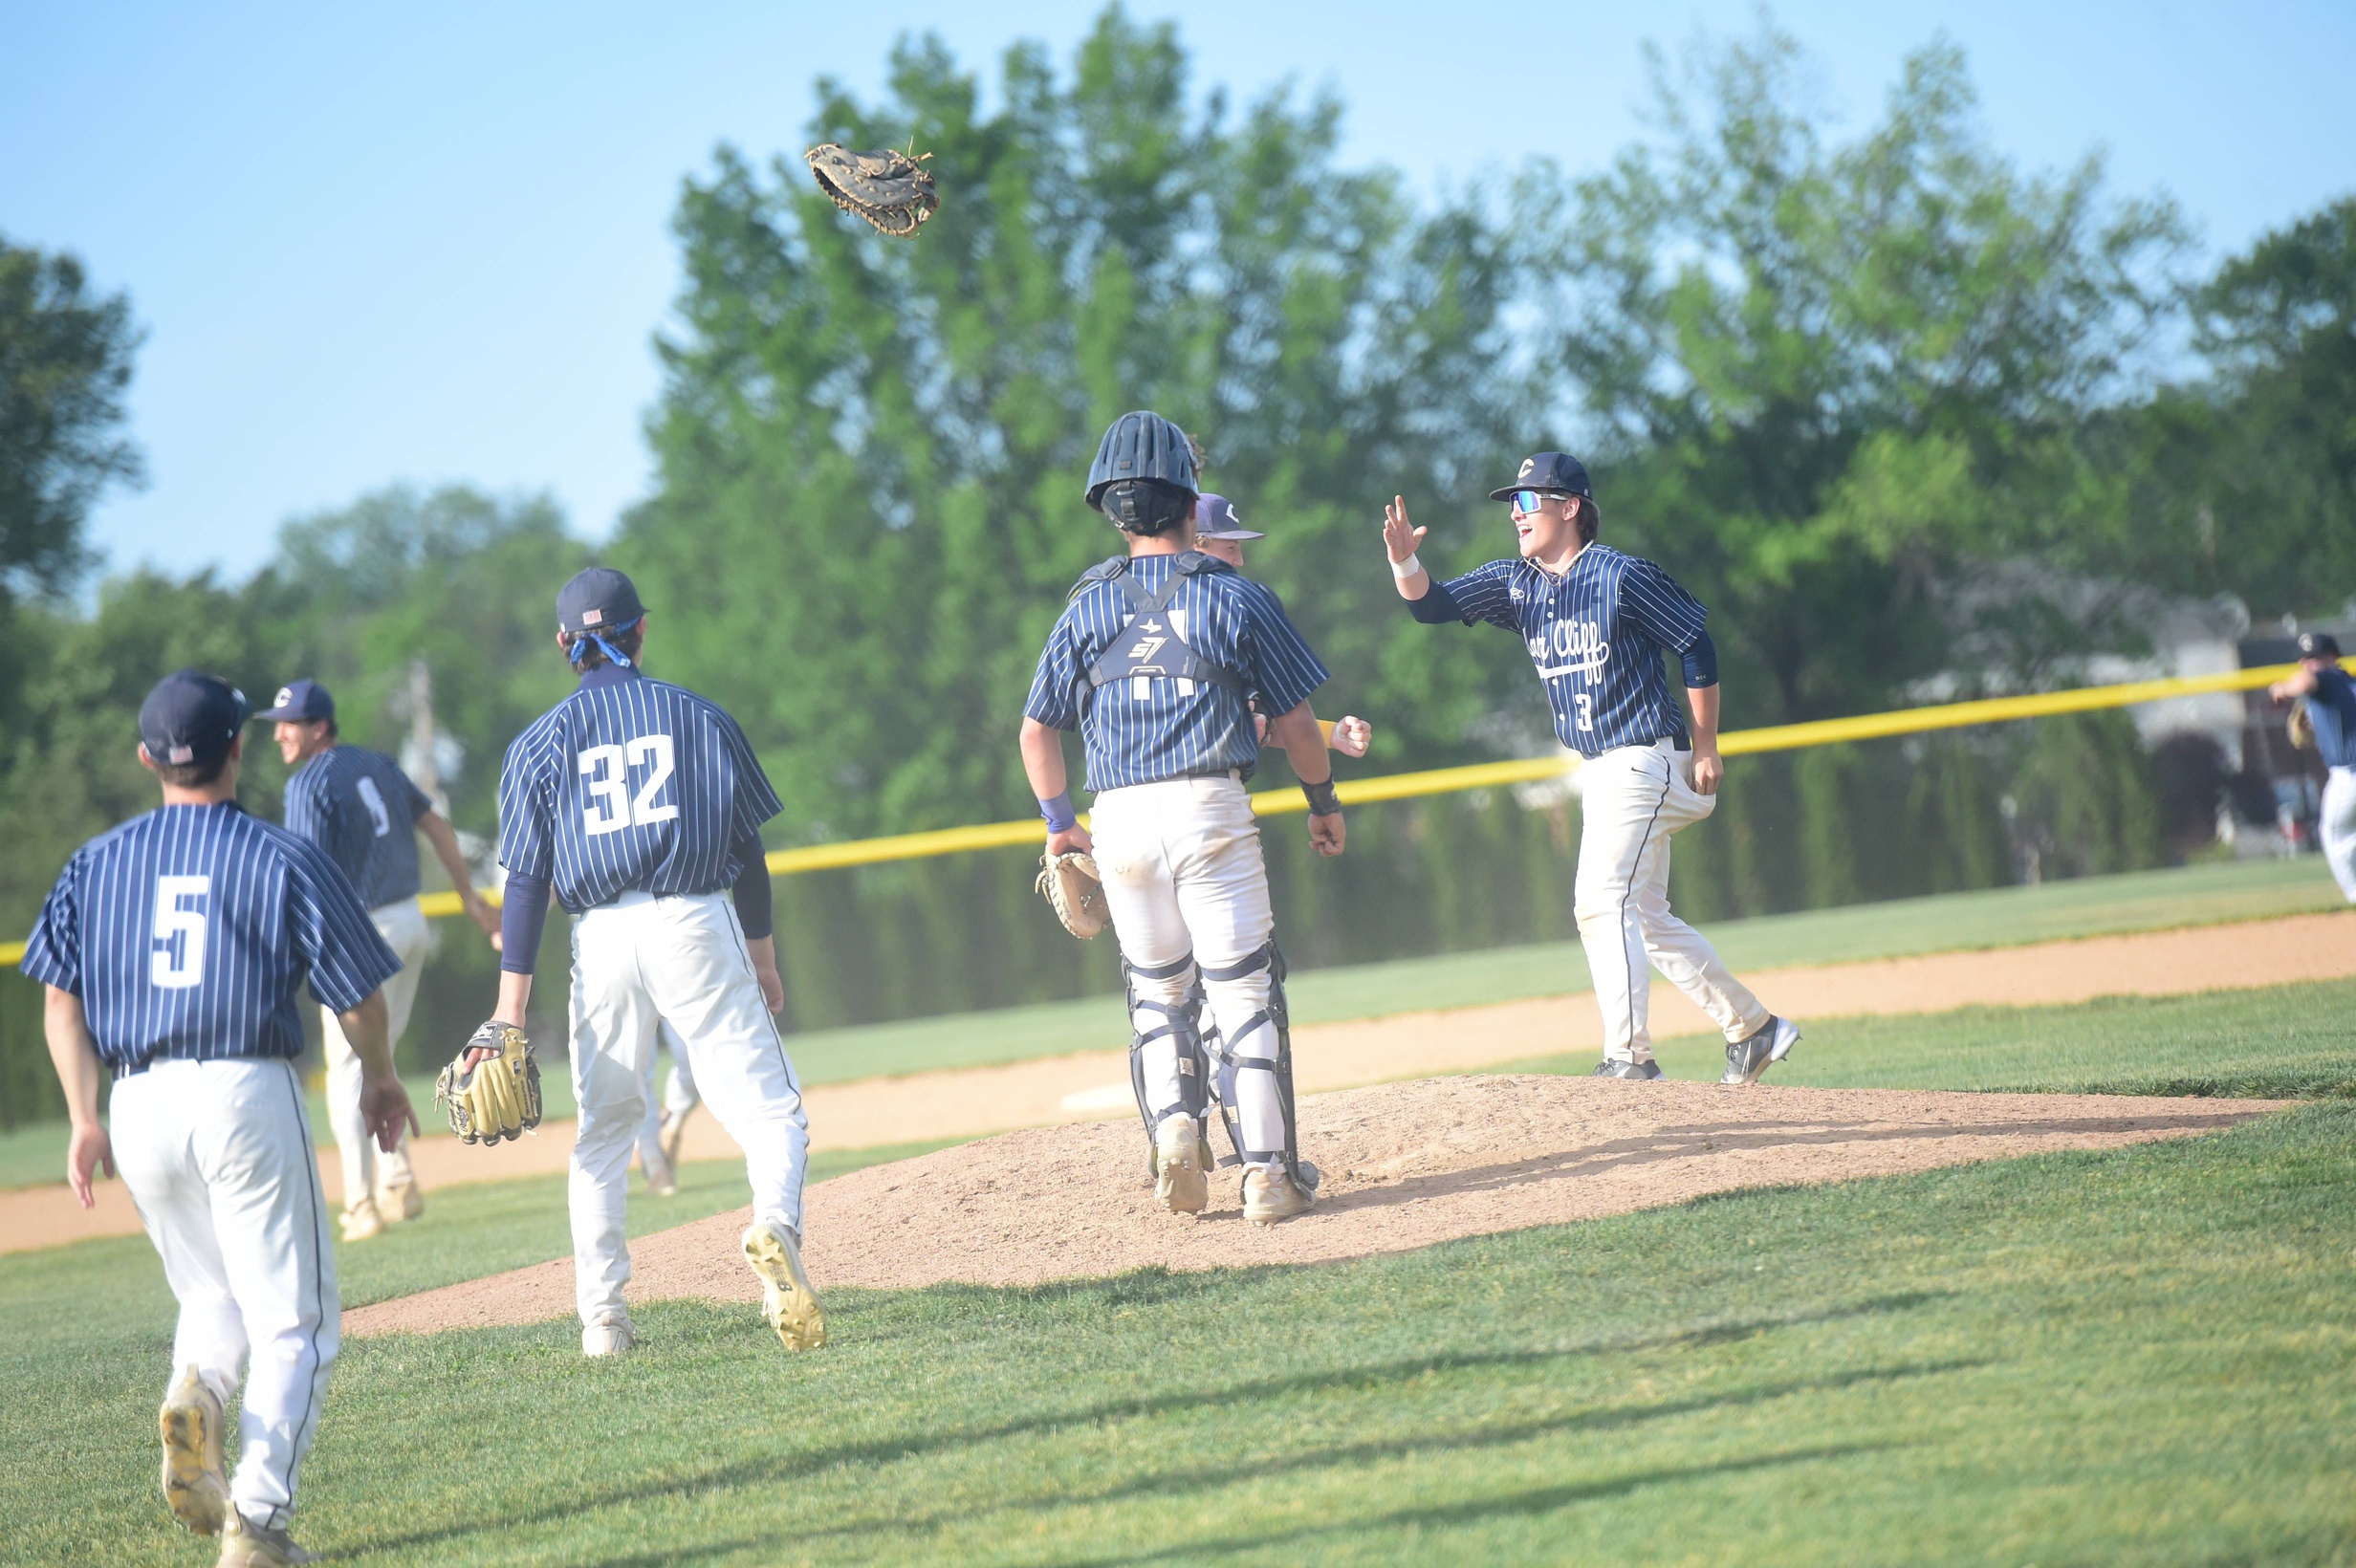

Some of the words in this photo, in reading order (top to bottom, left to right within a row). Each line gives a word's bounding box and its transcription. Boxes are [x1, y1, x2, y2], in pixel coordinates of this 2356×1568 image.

[1517, 458, 1535, 479] C
[1127, 637, 1169, 664] S7
[1554, 619, 1609, 686] Cliff
[1575, 693, 1594, 731] 3
[578, 734, 679, 836] 32
[151, 875, 209, 989] 5
